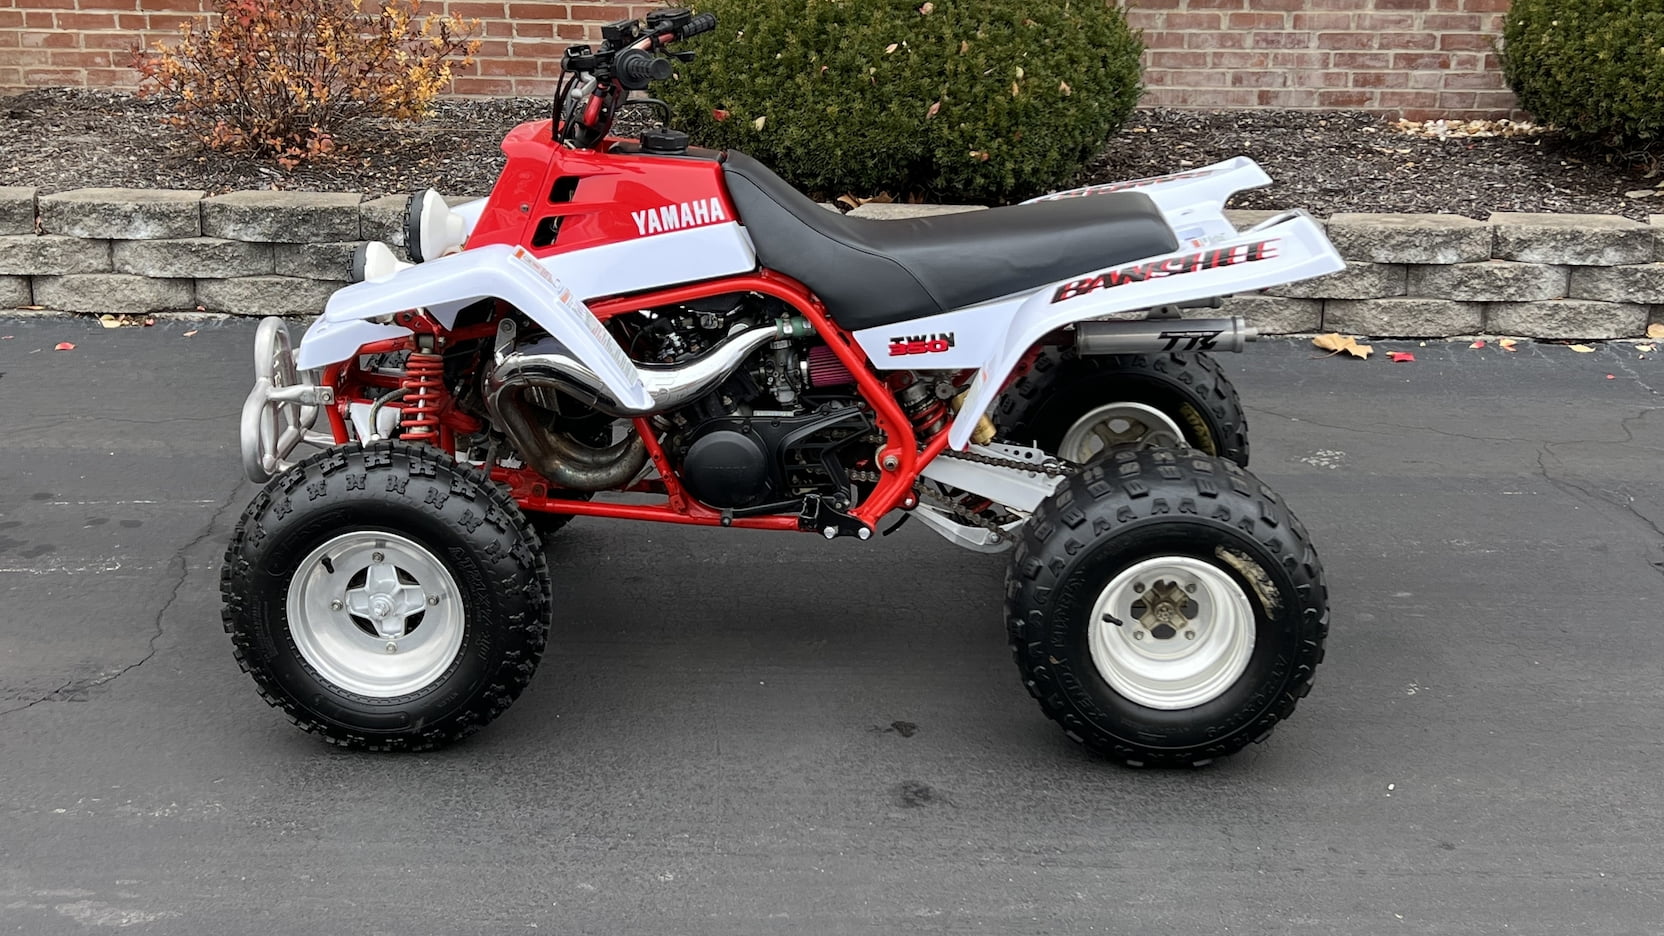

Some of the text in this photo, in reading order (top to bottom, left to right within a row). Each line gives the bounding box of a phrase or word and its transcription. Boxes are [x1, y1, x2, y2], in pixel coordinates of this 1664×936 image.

[630, 197, 726, 235] YAMAHA
[1050, 238, 1282, 304] BANSHEE
[888, 340, 949, 357] 350
[889, 332, 955, 348] TWIN
